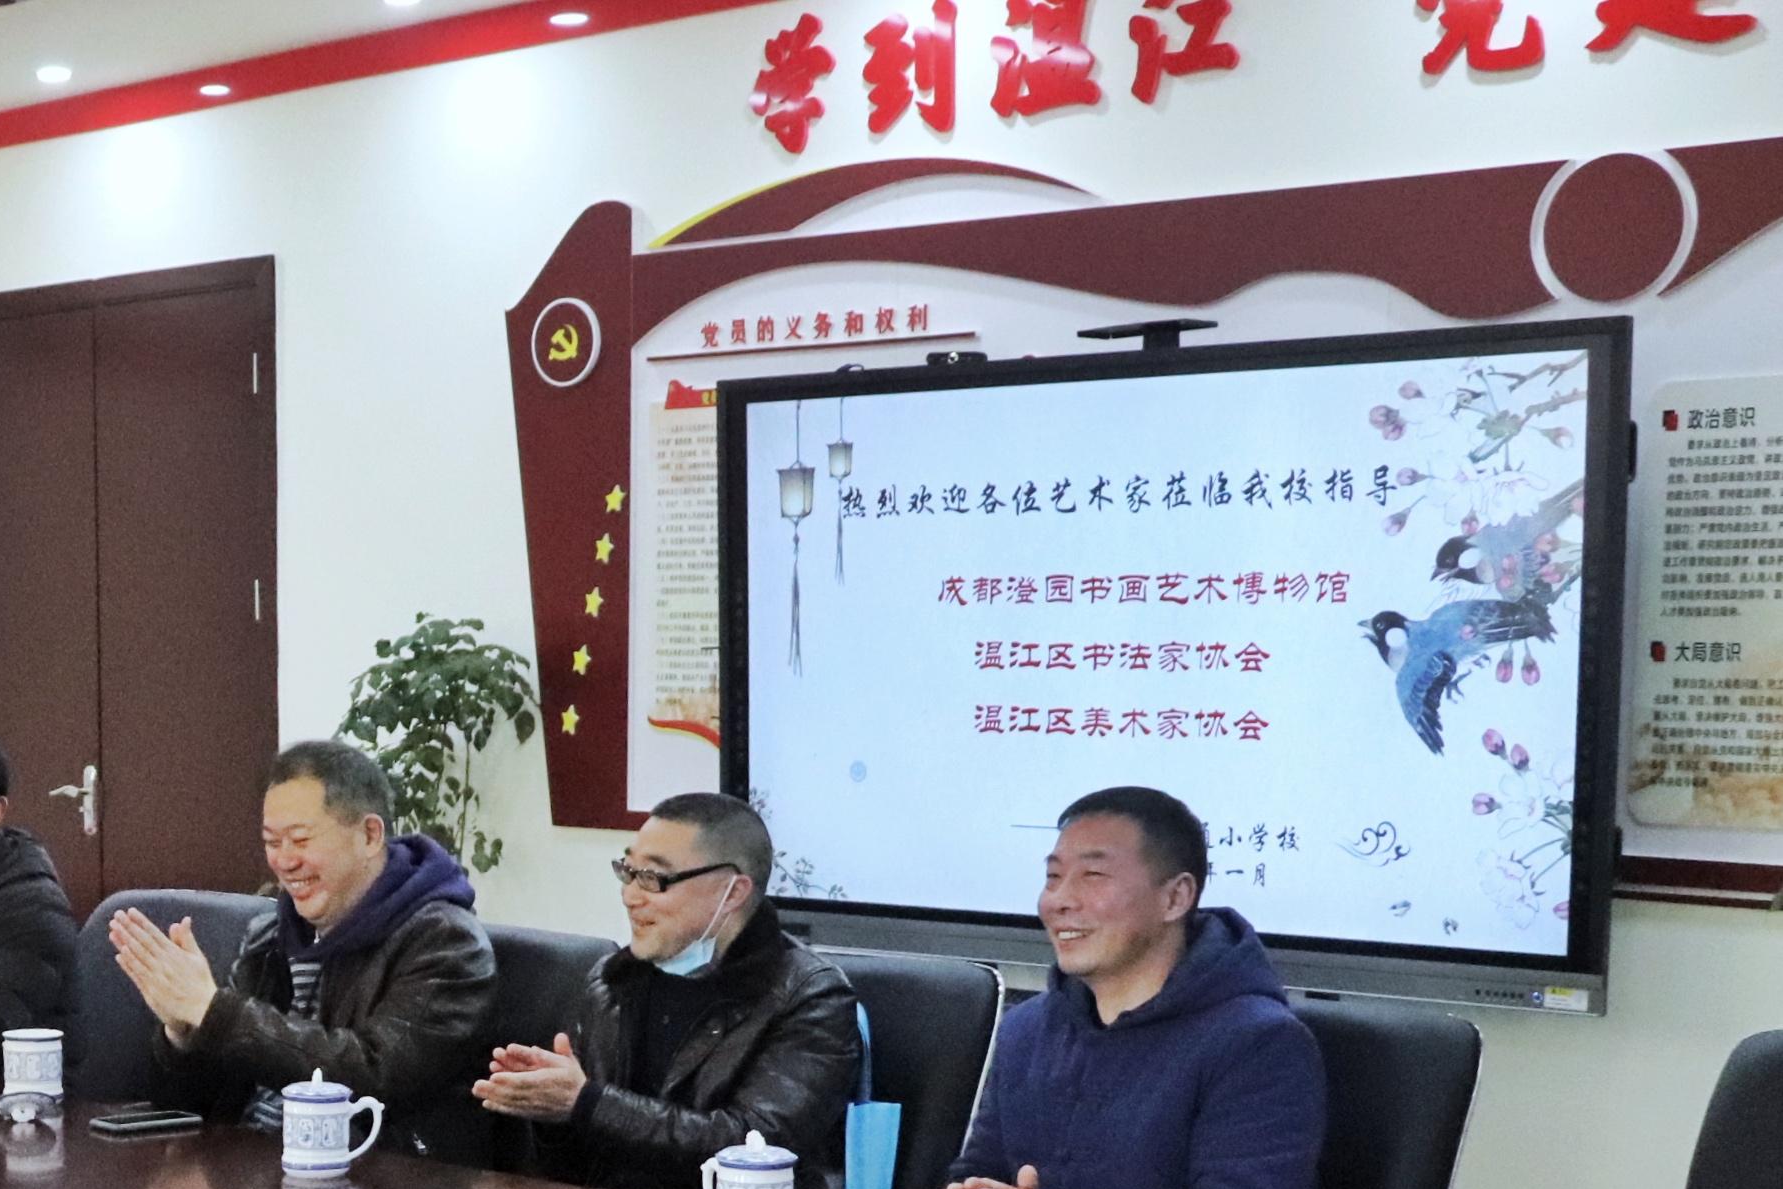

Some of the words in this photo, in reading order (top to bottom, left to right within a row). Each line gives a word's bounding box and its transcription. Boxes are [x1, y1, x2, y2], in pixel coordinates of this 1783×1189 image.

[701, 304, 929, 347] 党员的义务和权利
[1687, 406, 1756, 430] 政治意识
[841, 465, 1399, 519] 热烈欢迎各位艺术家莅临我校指导
[938, 571, 1350, 605] 成都澄园书画艺术博物馆
[974, 641, 1270, 672] 温江区书法家协会
[1674, 641, 1742, 663] 大局意识
[974, 704, 1269, 741] 温江区美术家协会
